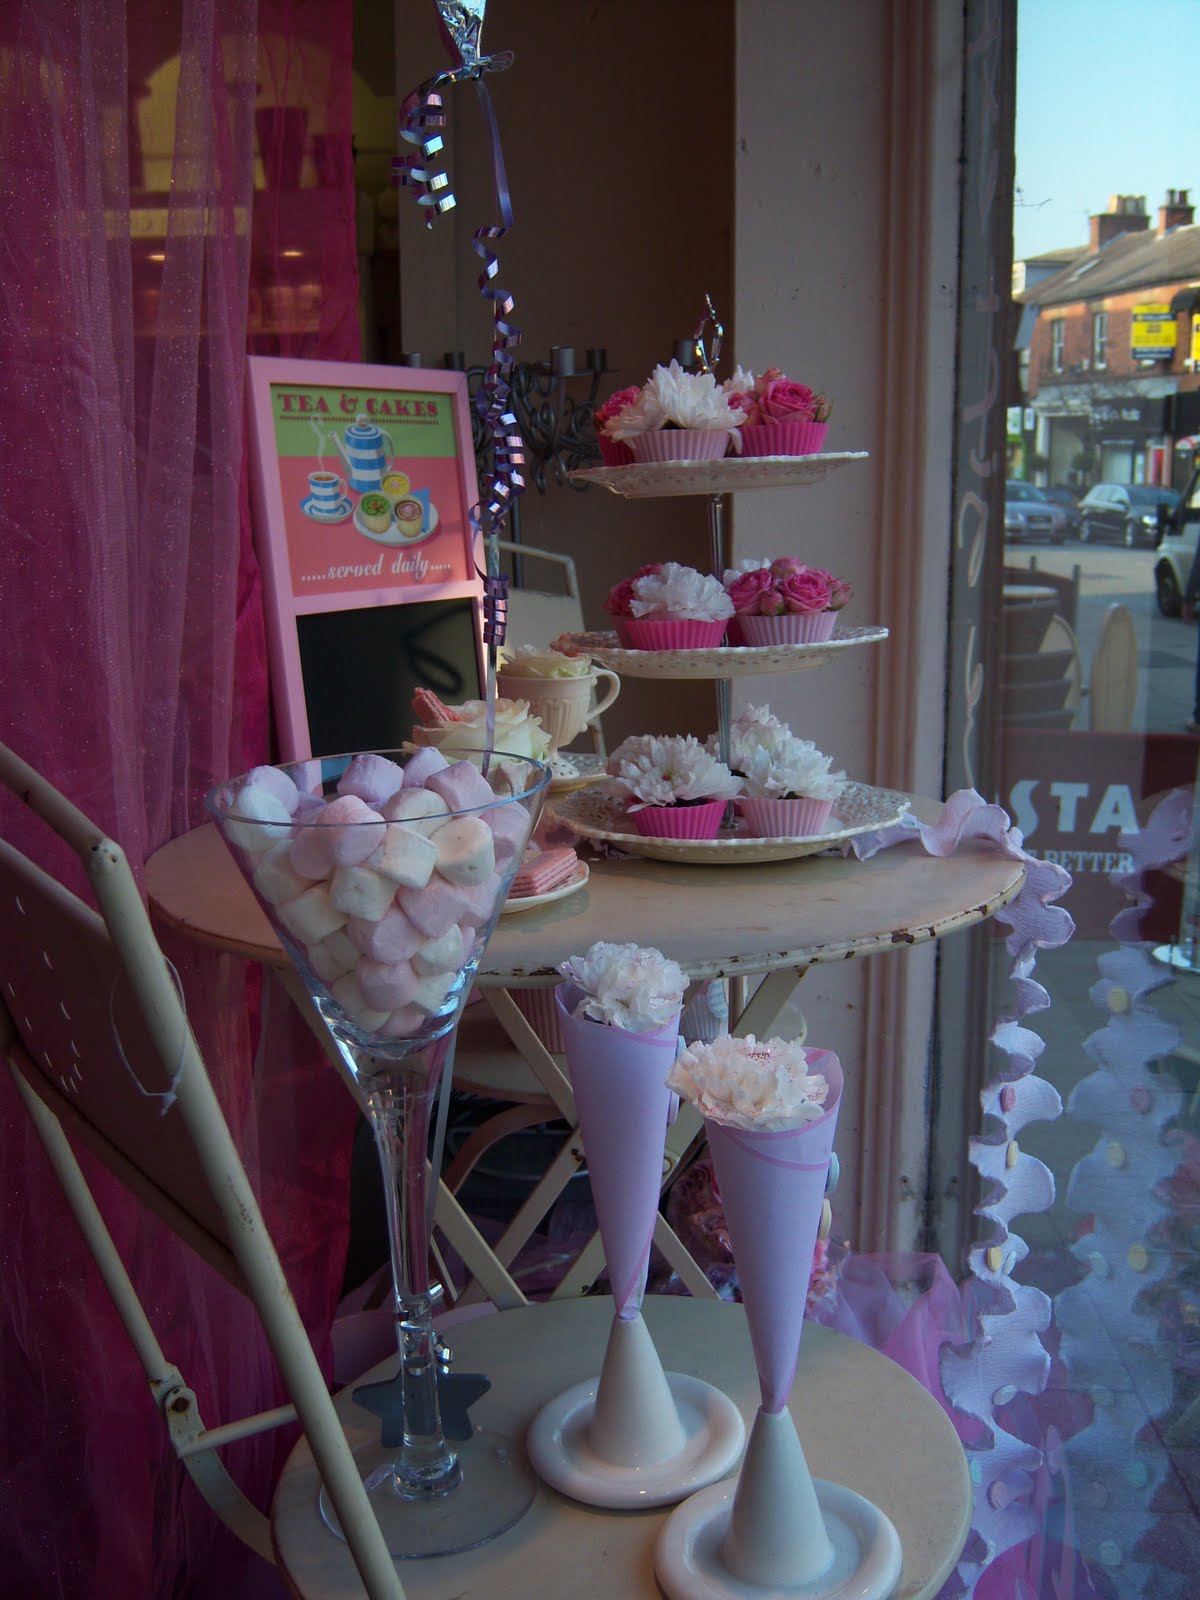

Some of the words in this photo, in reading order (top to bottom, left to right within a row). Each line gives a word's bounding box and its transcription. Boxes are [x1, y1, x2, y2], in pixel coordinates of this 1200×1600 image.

[277, 393, 330, 413] TEA
[340, 393, 359, 414] &
[366, 398, 439, 418] CAKES
